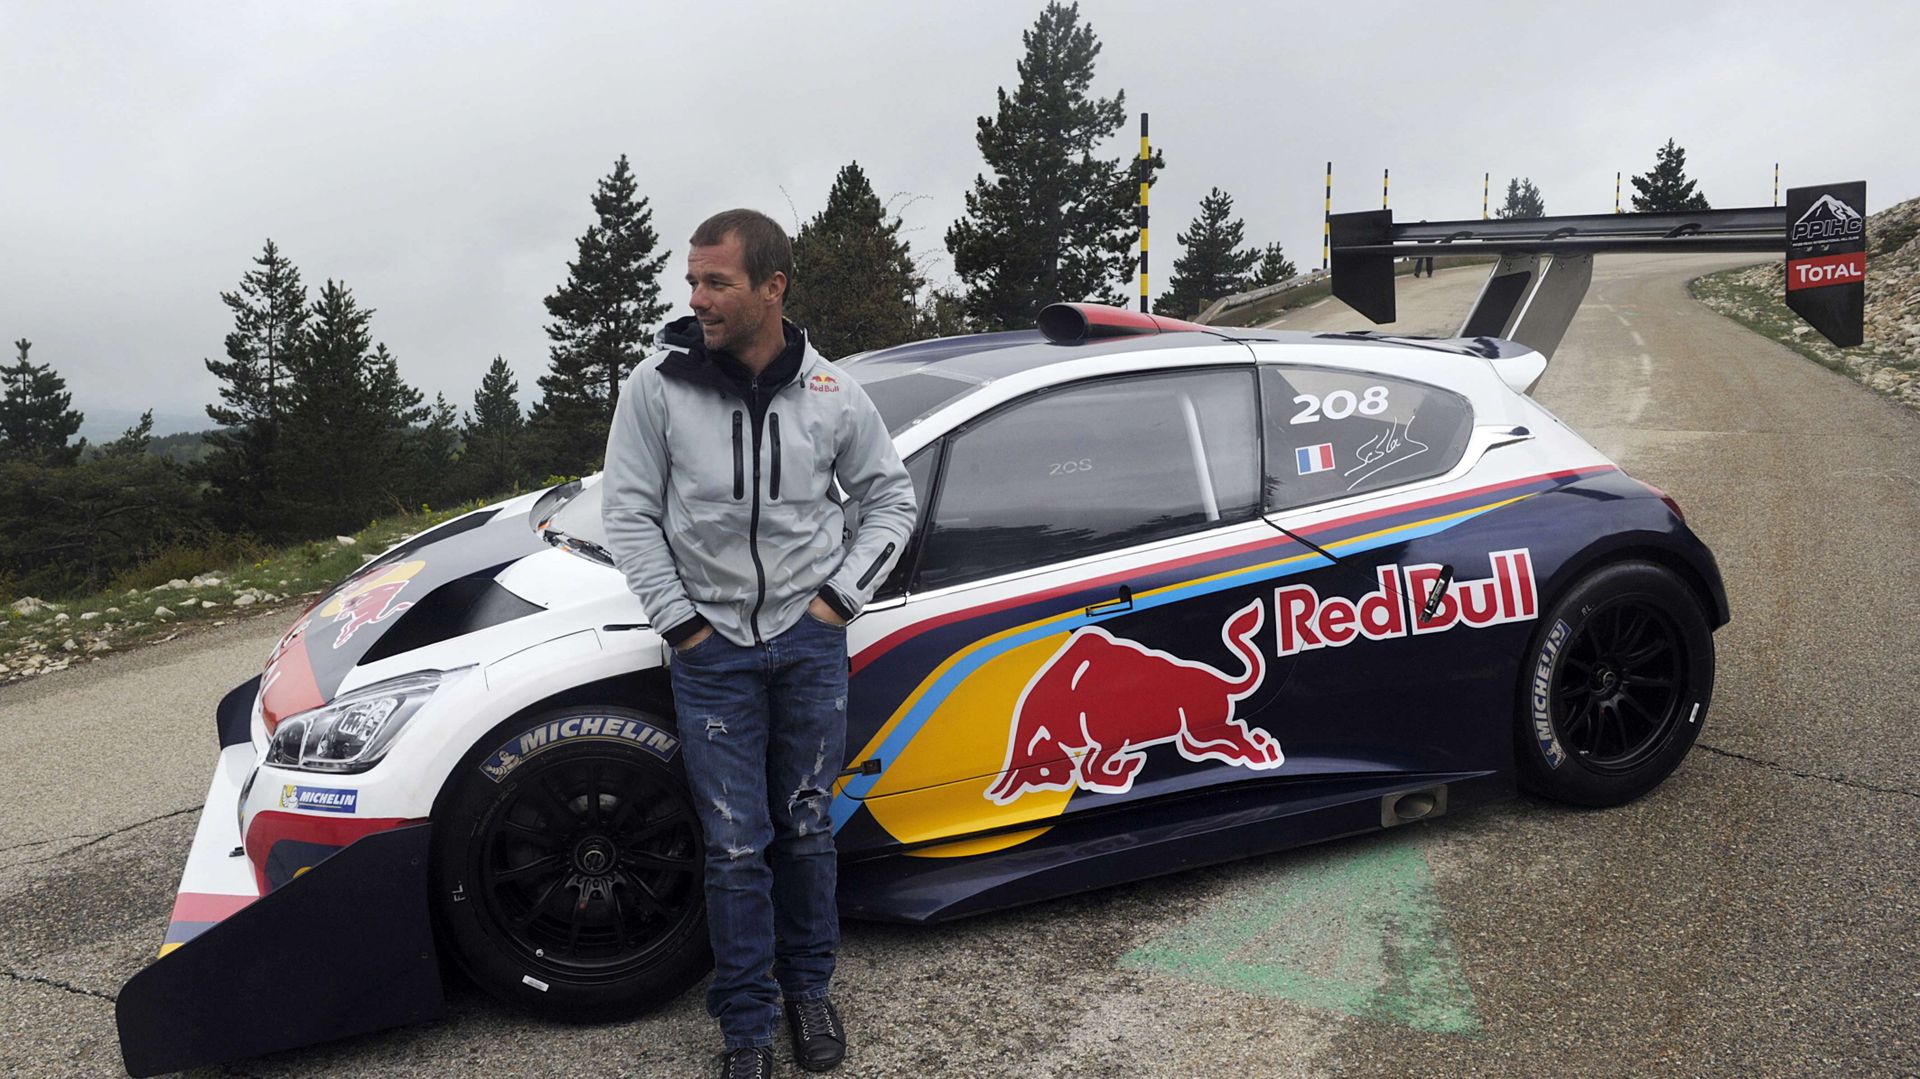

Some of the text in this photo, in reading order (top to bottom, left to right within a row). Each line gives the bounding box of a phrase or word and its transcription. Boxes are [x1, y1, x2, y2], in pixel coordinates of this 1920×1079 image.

[1792, 217, 1863, 240] PPIHC
[1796, 263, 1862, 283] TOTAL
[809, 382, 840, 393] Red Bull
[1289, 385, 1389, 425] 208
[1278, 551, 1536, 653] Red Bull
[519, 717, 677, 754] MICHELIN
[300, 791, 356, 806] MICHELIN
